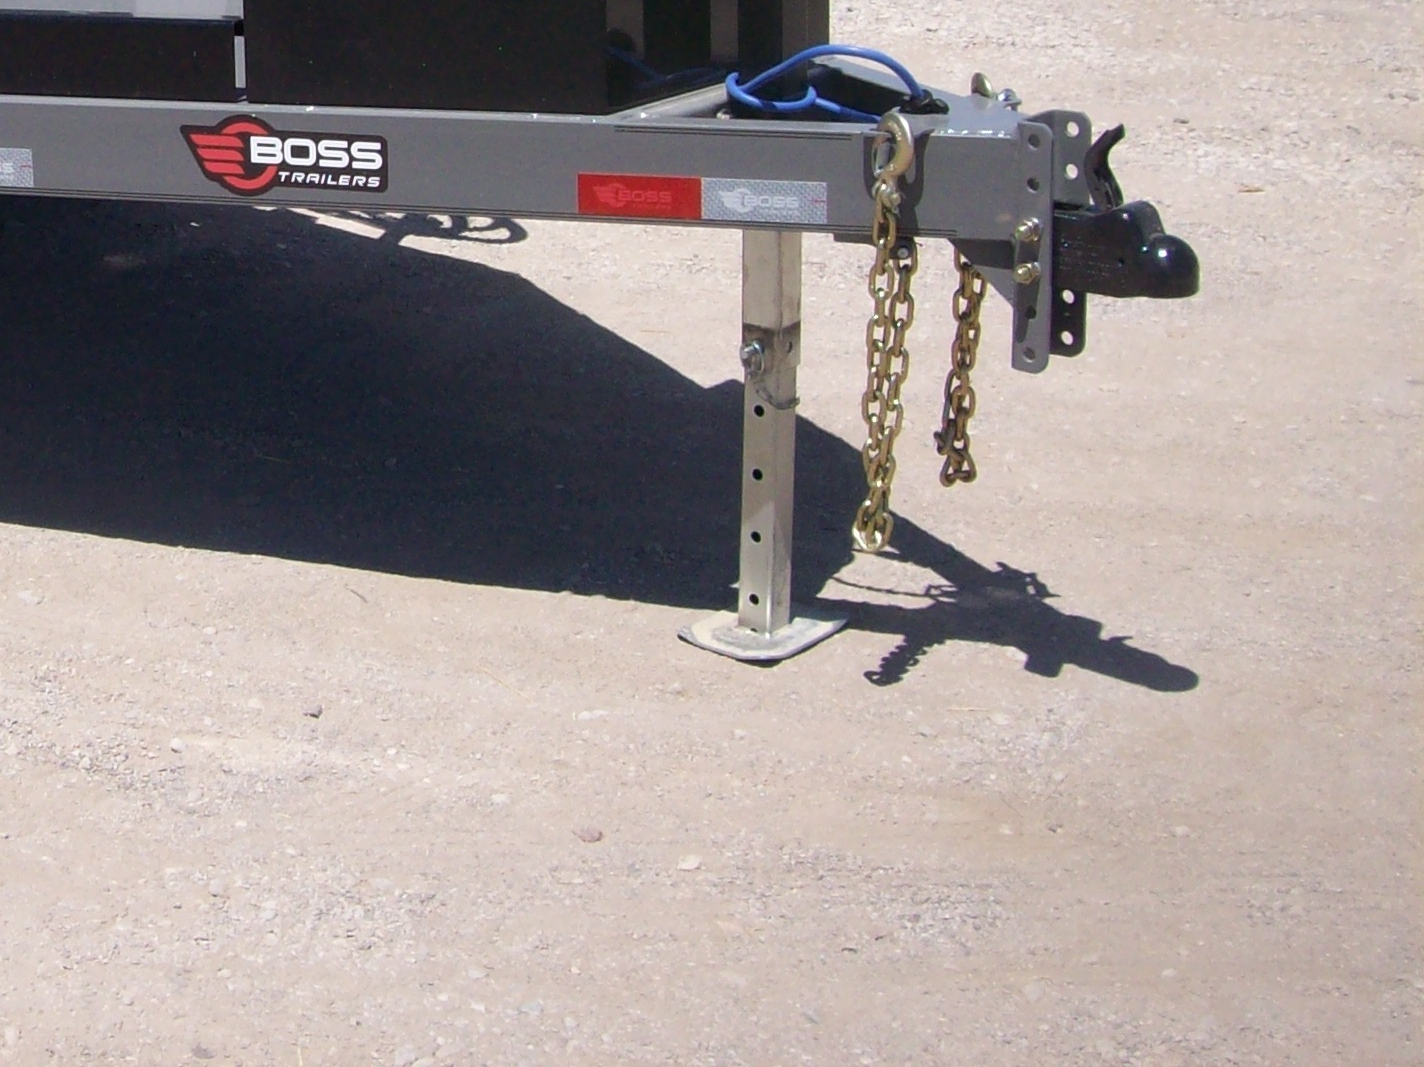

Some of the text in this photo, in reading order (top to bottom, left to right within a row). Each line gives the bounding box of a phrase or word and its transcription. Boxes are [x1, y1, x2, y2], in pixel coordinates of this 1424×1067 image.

[249, 135, 383, 170] BOSS
[278, 171, 381, 188] TRAILERS
[618, 189, 672, 203] BOSS
[744, 194, 799, 209] BOSS
